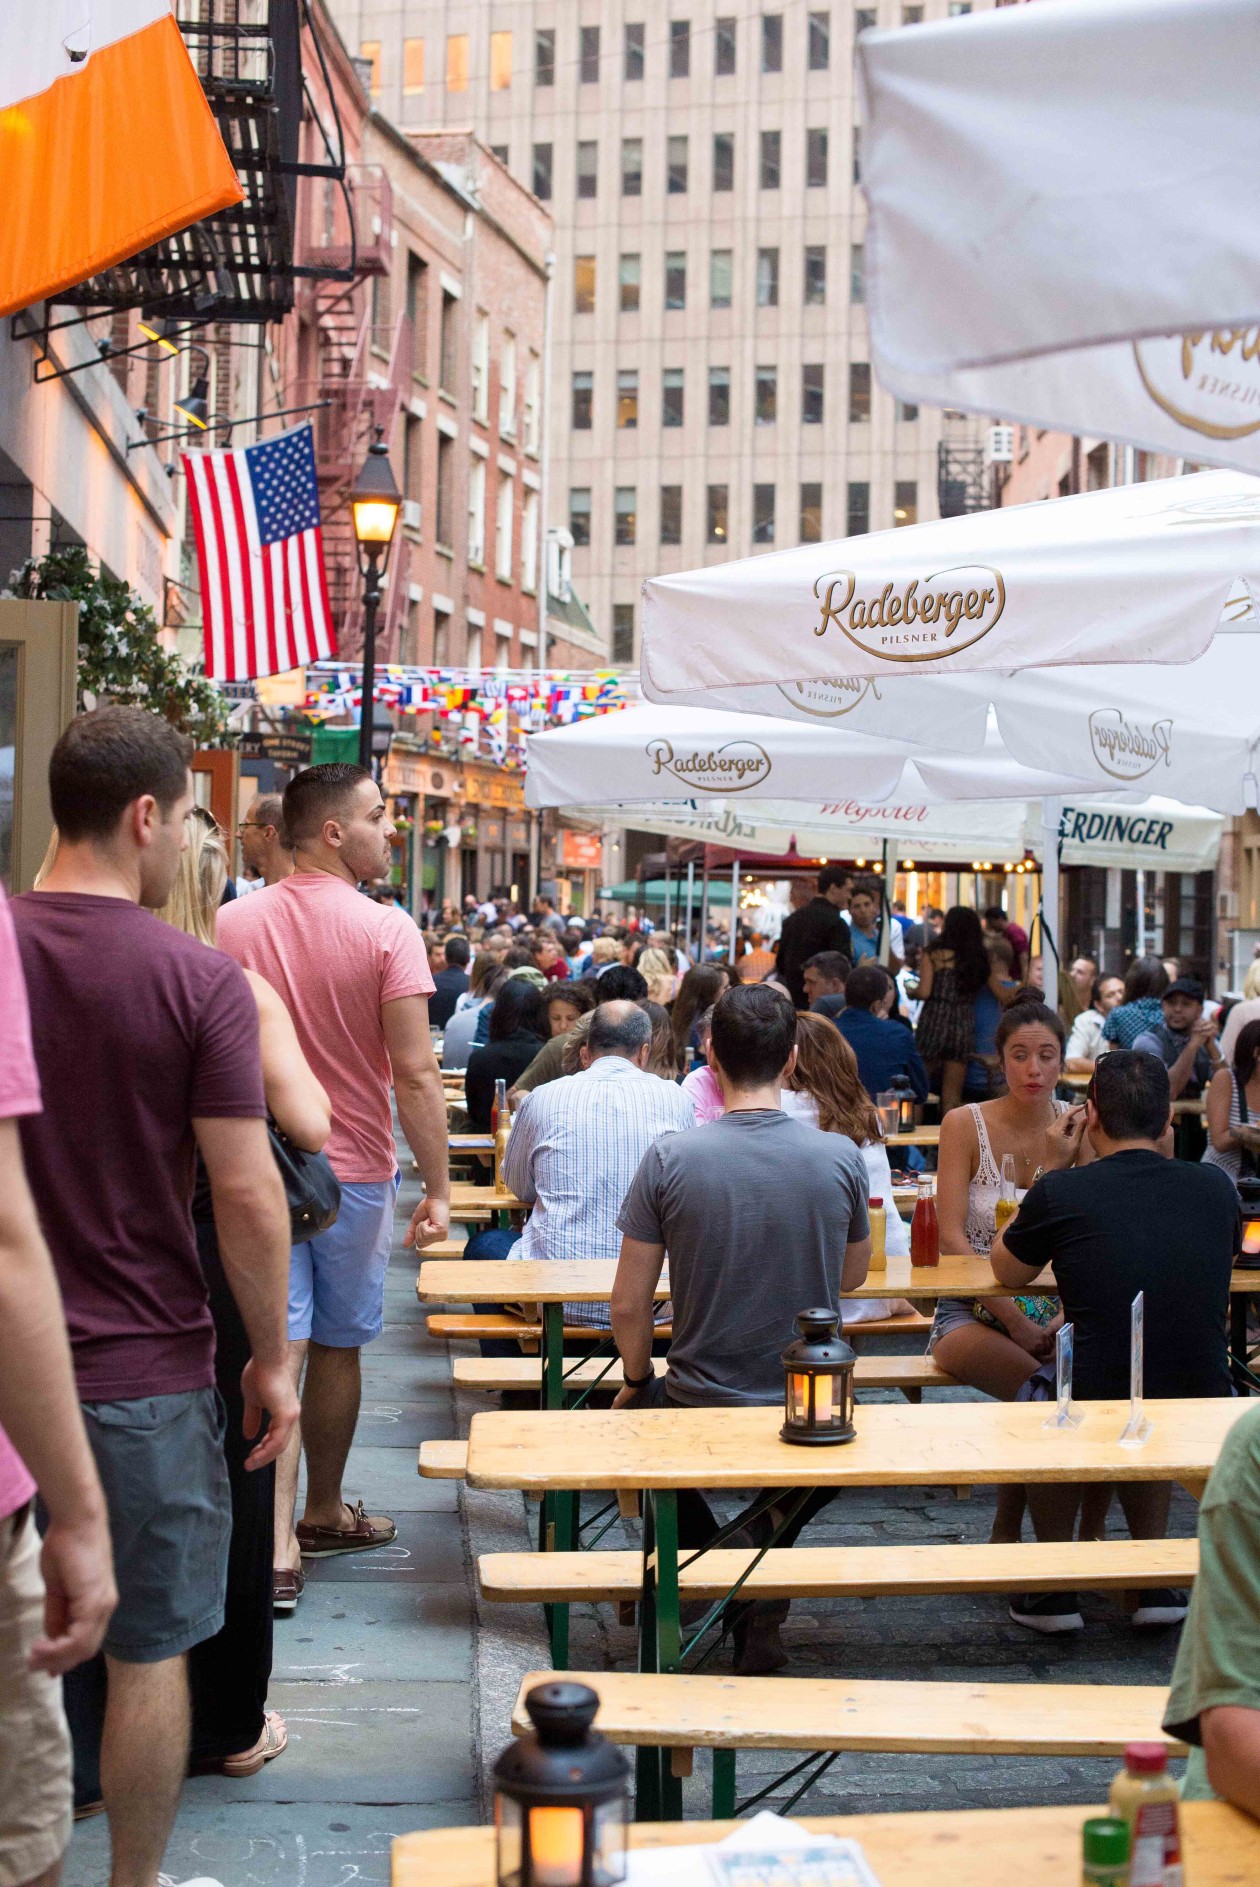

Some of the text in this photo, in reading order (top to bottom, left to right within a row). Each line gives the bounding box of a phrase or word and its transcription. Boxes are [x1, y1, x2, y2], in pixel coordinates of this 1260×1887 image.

[813, 569, 996, 637] Radeberger
[881, 633, 938, 645] PILSNER
[646, 738, 765, 779] Radeberger
[1058, 807, 1174, 850] ERDINGER
